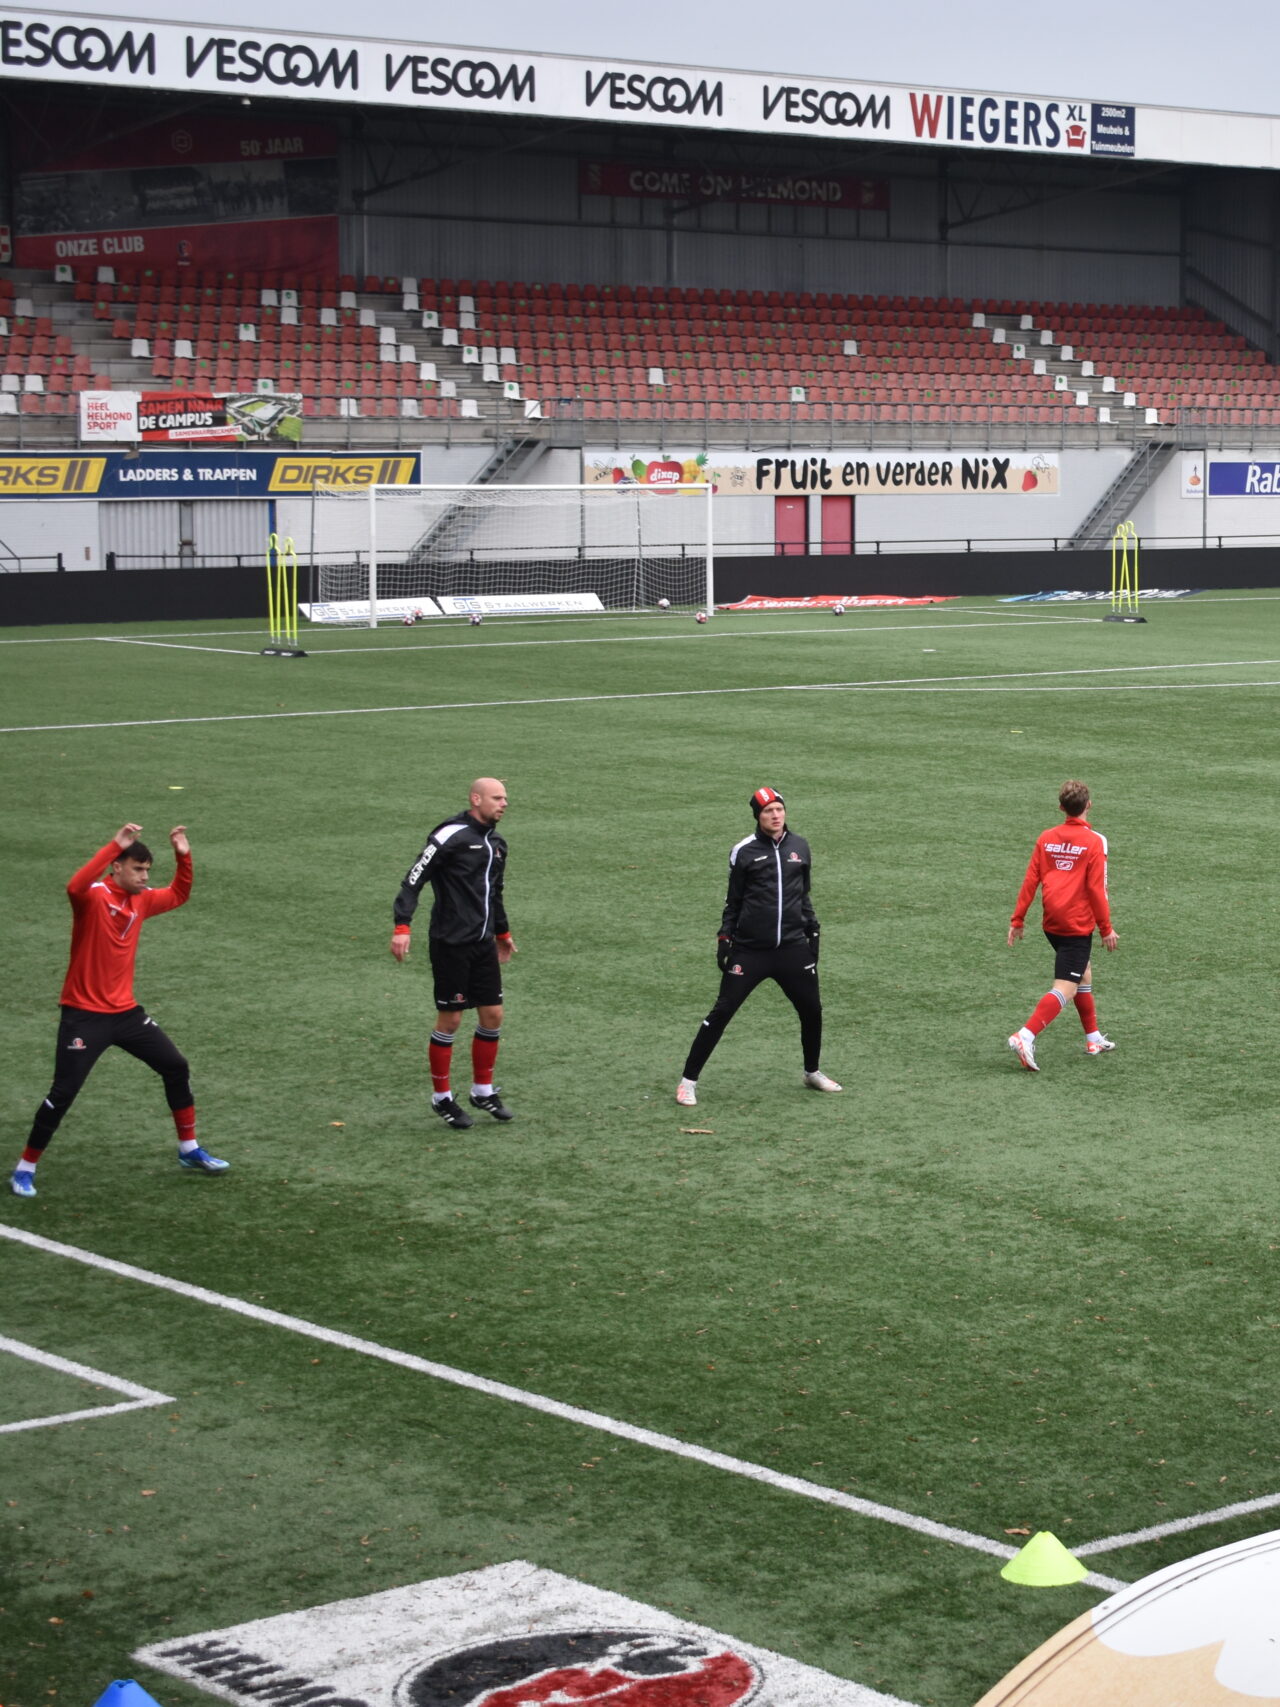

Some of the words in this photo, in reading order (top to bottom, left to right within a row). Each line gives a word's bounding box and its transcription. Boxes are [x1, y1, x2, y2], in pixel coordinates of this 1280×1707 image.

[0, 20, 156, 75] ESCOM
[186, 35, 358, 91] VESCOM
[385, 53, 535, 103] VESCOM
[585, 70, 723, 118] VESCOM
[763, 84, 891, 130] VESCOM
[909, 92, 1060, 149] WIEGERS
[1066, 104, 1087, 122] XL
[1096, 123, 1124, 136] Meubels
[1124, 126, 1130, 136] &
[264, 136, 305, 155] JAAR
[1091, 140, 1135, 154] Tuinmeubelen
[699, 175, 732, 196] ON
[55, 238, 99, 258] ONZE
[103, 235, 145, 255] CLUB
[87, 402, 110, 412] HEEL
[87, 412, 132, 421] HELMOND
[139, 401, 186, 417] SAMEN
[188, 399, 224, 412] NAAR
[87, 421, 118, 430] SPORT
[139, 415, 155, 430] DE
[158, 412, 214, 429] CAMPUS
[118, 468, 179, 482] LADDERS
[182, 468, 194, 481] &
[197, 467, 257, 481] TRAPPEN
[279, 464, 374, 485] DIRKS
[650, 468, 680, 483] dixap
[756, 457, 832, 490] Fruit
[842, 460, 869, 486] en
